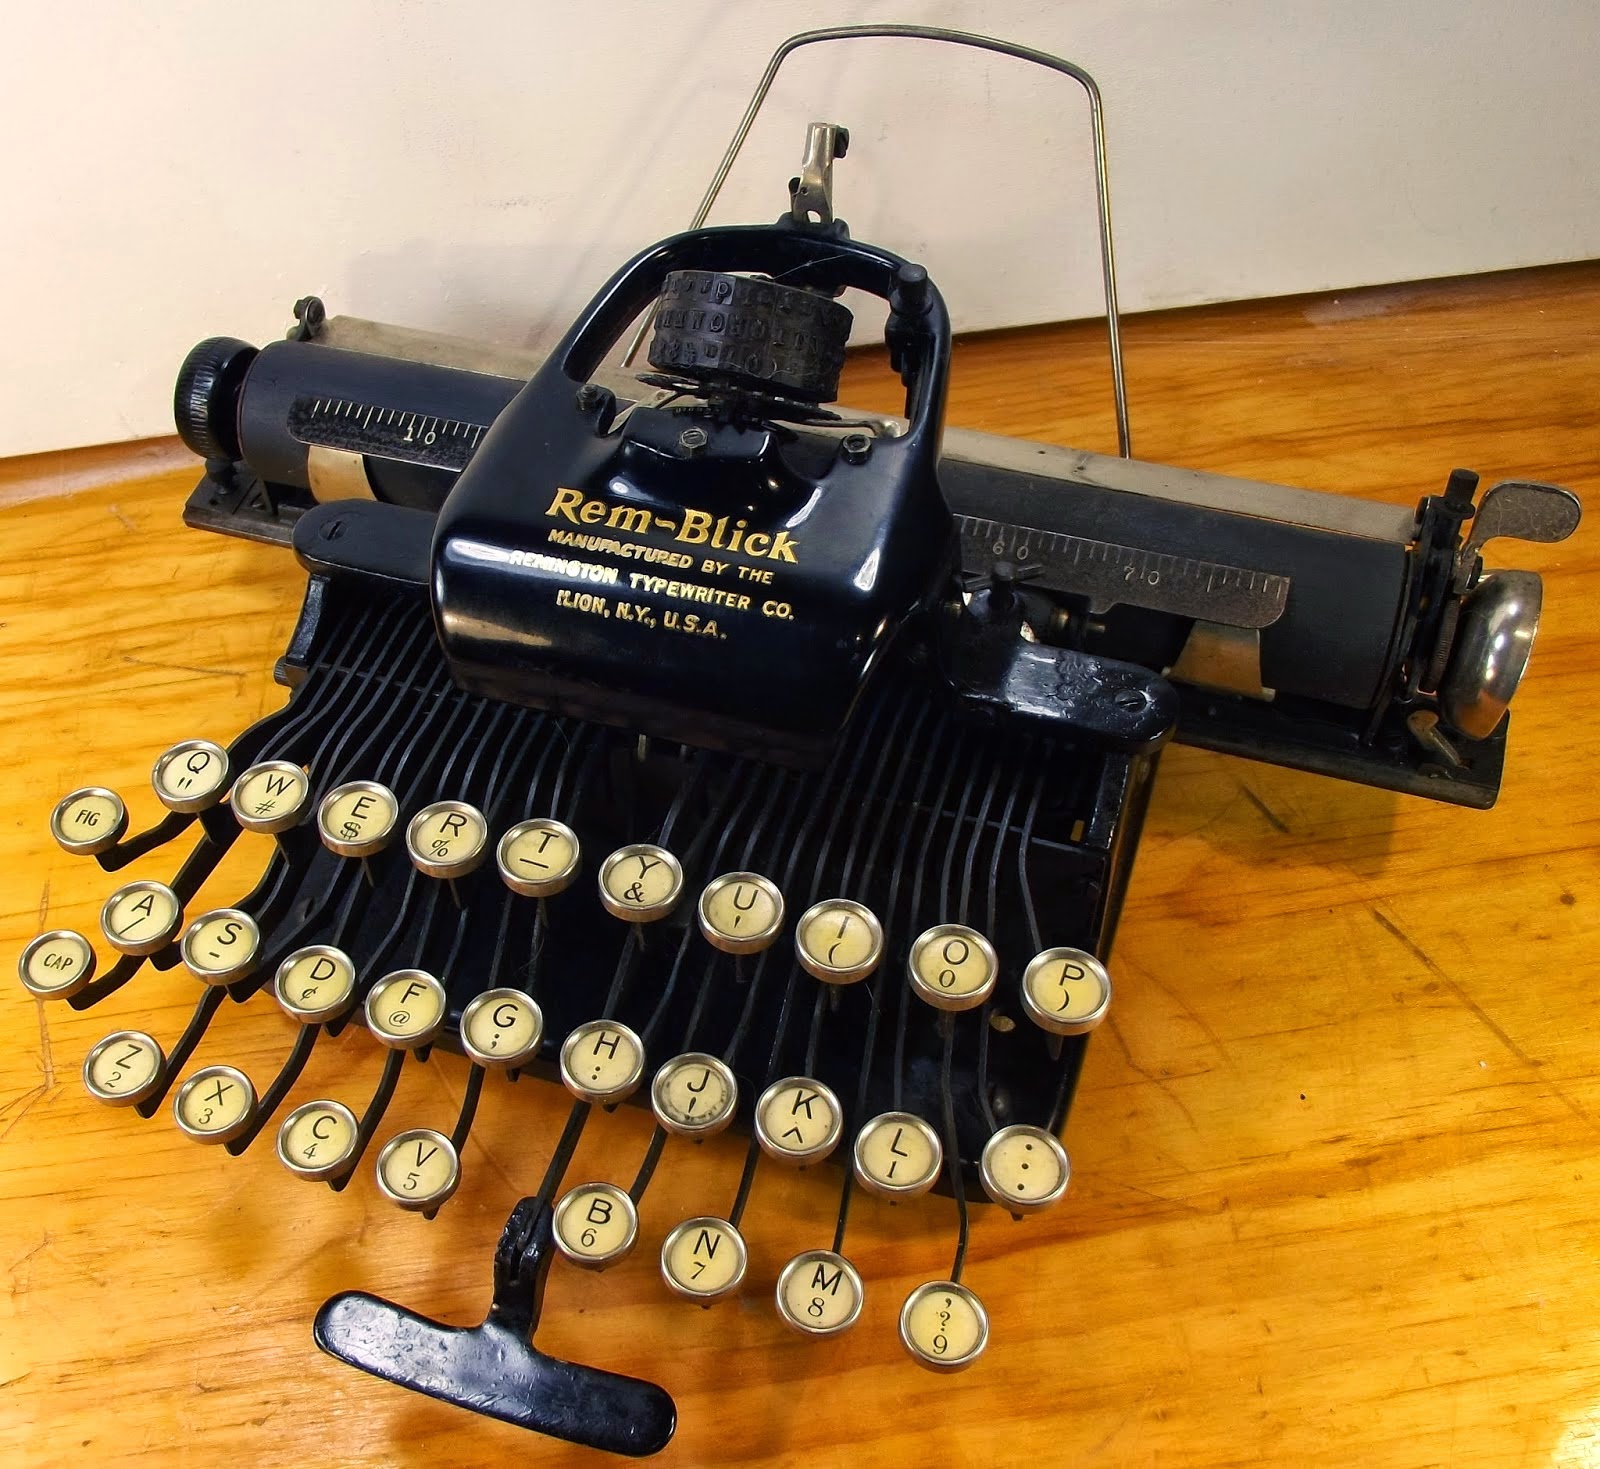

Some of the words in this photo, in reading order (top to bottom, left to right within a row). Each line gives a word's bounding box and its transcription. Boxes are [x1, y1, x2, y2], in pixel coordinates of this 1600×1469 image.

[403, 426, 438, 446] 10
[547, 528, 694, 569] MANUFACTURED
[701, 559, 731, 576] BY
[737, 565, 775, 585] THE
[992, 541, 1030, 561] 60
[1123, 566, 1160, 586] 70
[629, 572, 751, 611] TYPEWRITER
[761, 600, 795, 622] CO.
[556, 588, 611, 619] ILION,
[663, 610, 728, 641] U.S.A.
[186, 751, 210, 773] Q
[266, 774, 295, 796] W
[75, 810, 99, 826] FIG
[352, 797, 376, 818] E
[440, 813, 467, 837] R
[539, 831, 559, 853] T
[637, 856, 661, 879] Y
[131, 895, 154, 916] A
[734, 886, 758, 910] U
[217, 923, 242, 944] S
[44, 954, 73, 970] CAP
[943, 940, 969, 965] O
[310, 959, 335, 980] D
[1059, 963, 1084, 985] P
[401, 983, 427, 1003] F
[493, 1004, 518, 1027] G
[116, 1044, 142, 1069] Z
[593, 1032, 620, 1059] H
[105, 1072, 121, 1087] 2
[687, 1069, 710, 1092] J
[205, 1080, 233, 1105] X
[792, 1089, 818, 1119] K
[199, 1108, 213, 1124] 3
[313, 1116, 337, 1139] C
[304, 1144, 317, 1159] 4
[891, 1128, 907, 1157] L
[417, 1142, 438, 1167] V
[403, 1173, 420, 1190] 5
[587, 1198, 612, 1224] B
[581, 1229, 596, 1247] 6
[694, 1230, 720, 1259] N
[691, 1262, 705, 1279] 7
[812, 1263, 842, 1295] M
[808, 1298, 824, 1317] 8
[933, 1335, 947, 1354] 9
